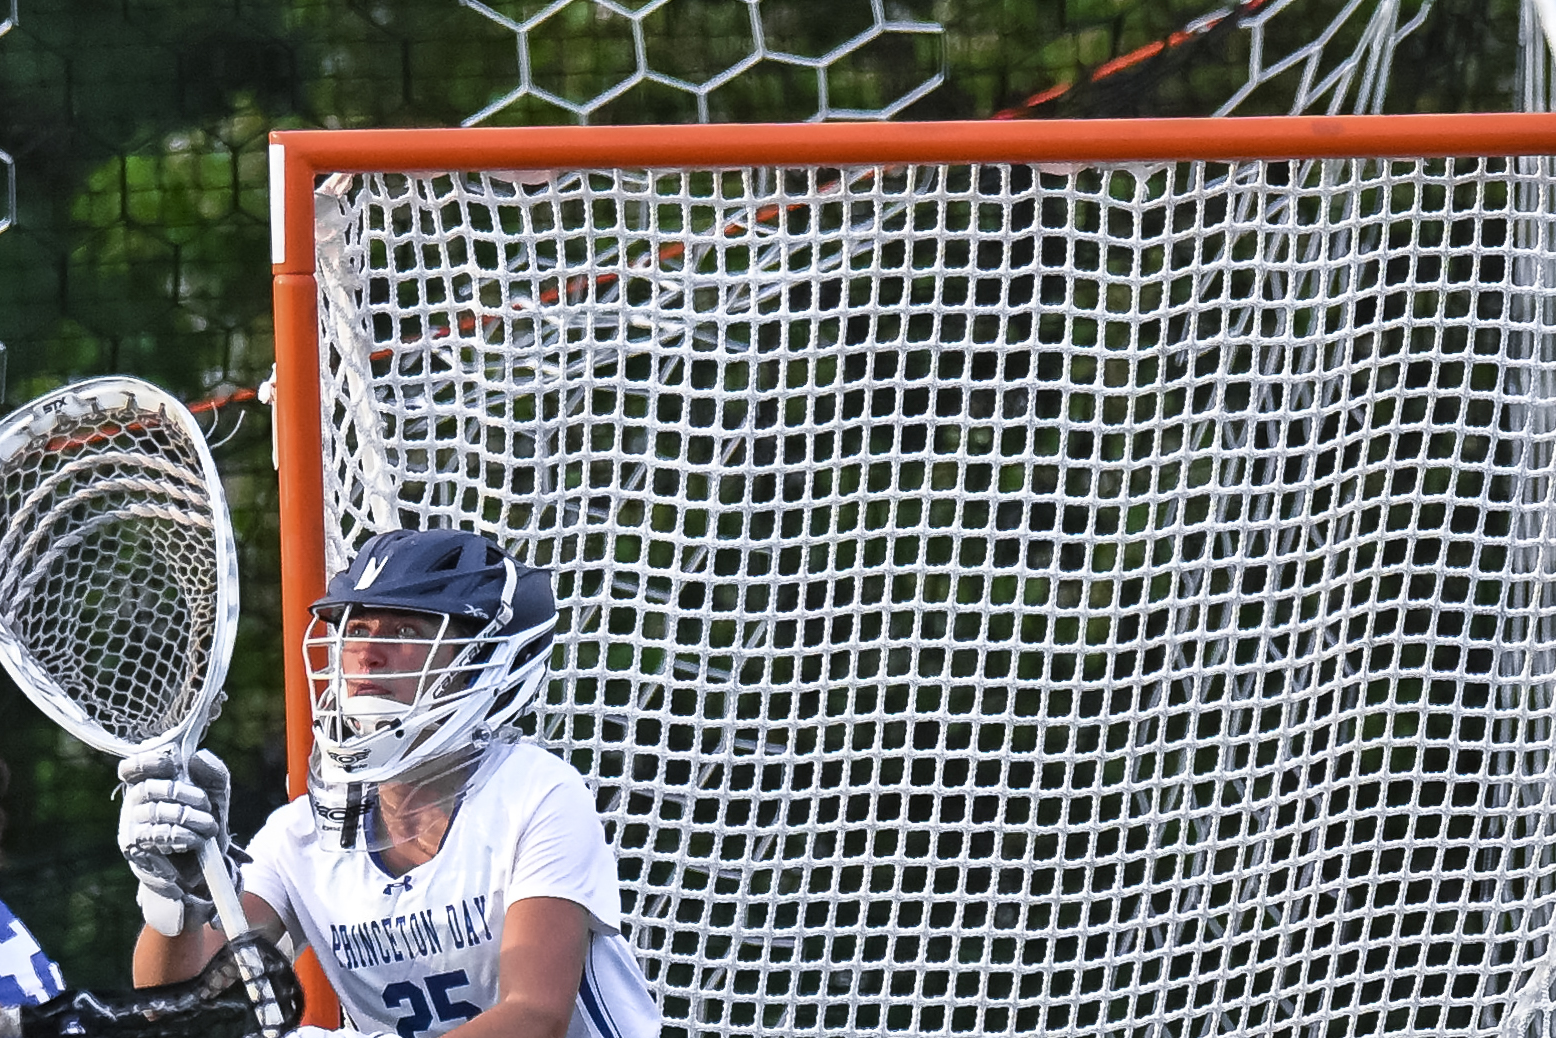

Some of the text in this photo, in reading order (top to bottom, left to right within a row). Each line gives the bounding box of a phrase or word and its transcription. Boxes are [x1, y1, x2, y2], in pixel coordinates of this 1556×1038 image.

[42, 396, 68, 415] STX
[330, 895, 493, 970] PRINCETON DAY
